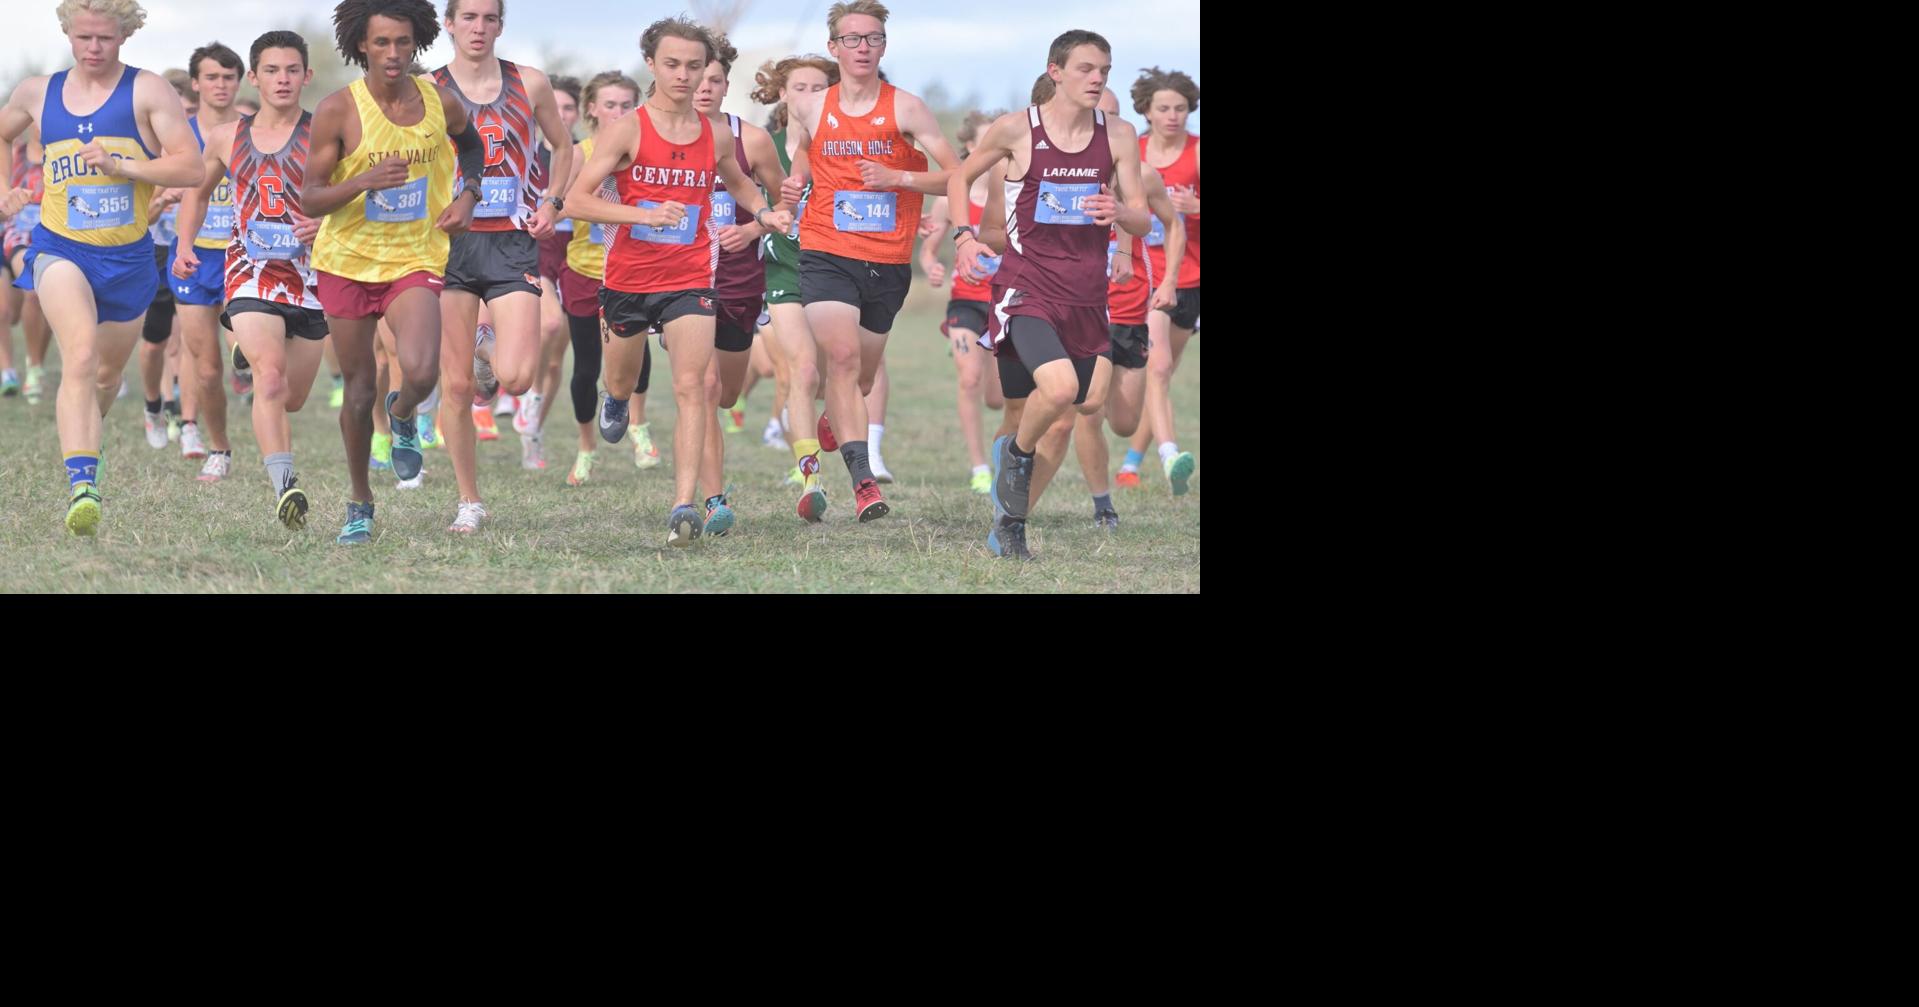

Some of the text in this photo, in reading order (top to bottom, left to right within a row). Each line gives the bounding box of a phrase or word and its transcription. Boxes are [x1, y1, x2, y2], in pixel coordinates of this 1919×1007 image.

[477, 124, 505, 166] C
[822, 140, 864, 156] JACKSON
[632, 164, 714, 188] CENTRA
[1043, 167, 1100, 178] LARAMIE
[257, 175, 286, 217] C
[398, 191, 422, 208] 387
[490, 188, 515, 203] 243
[98, 196, 130, 214] 355
[714, 202, 732, 218] 96
[866, 203, 890, 218] 144
[273, 233, 300, 249] 244
